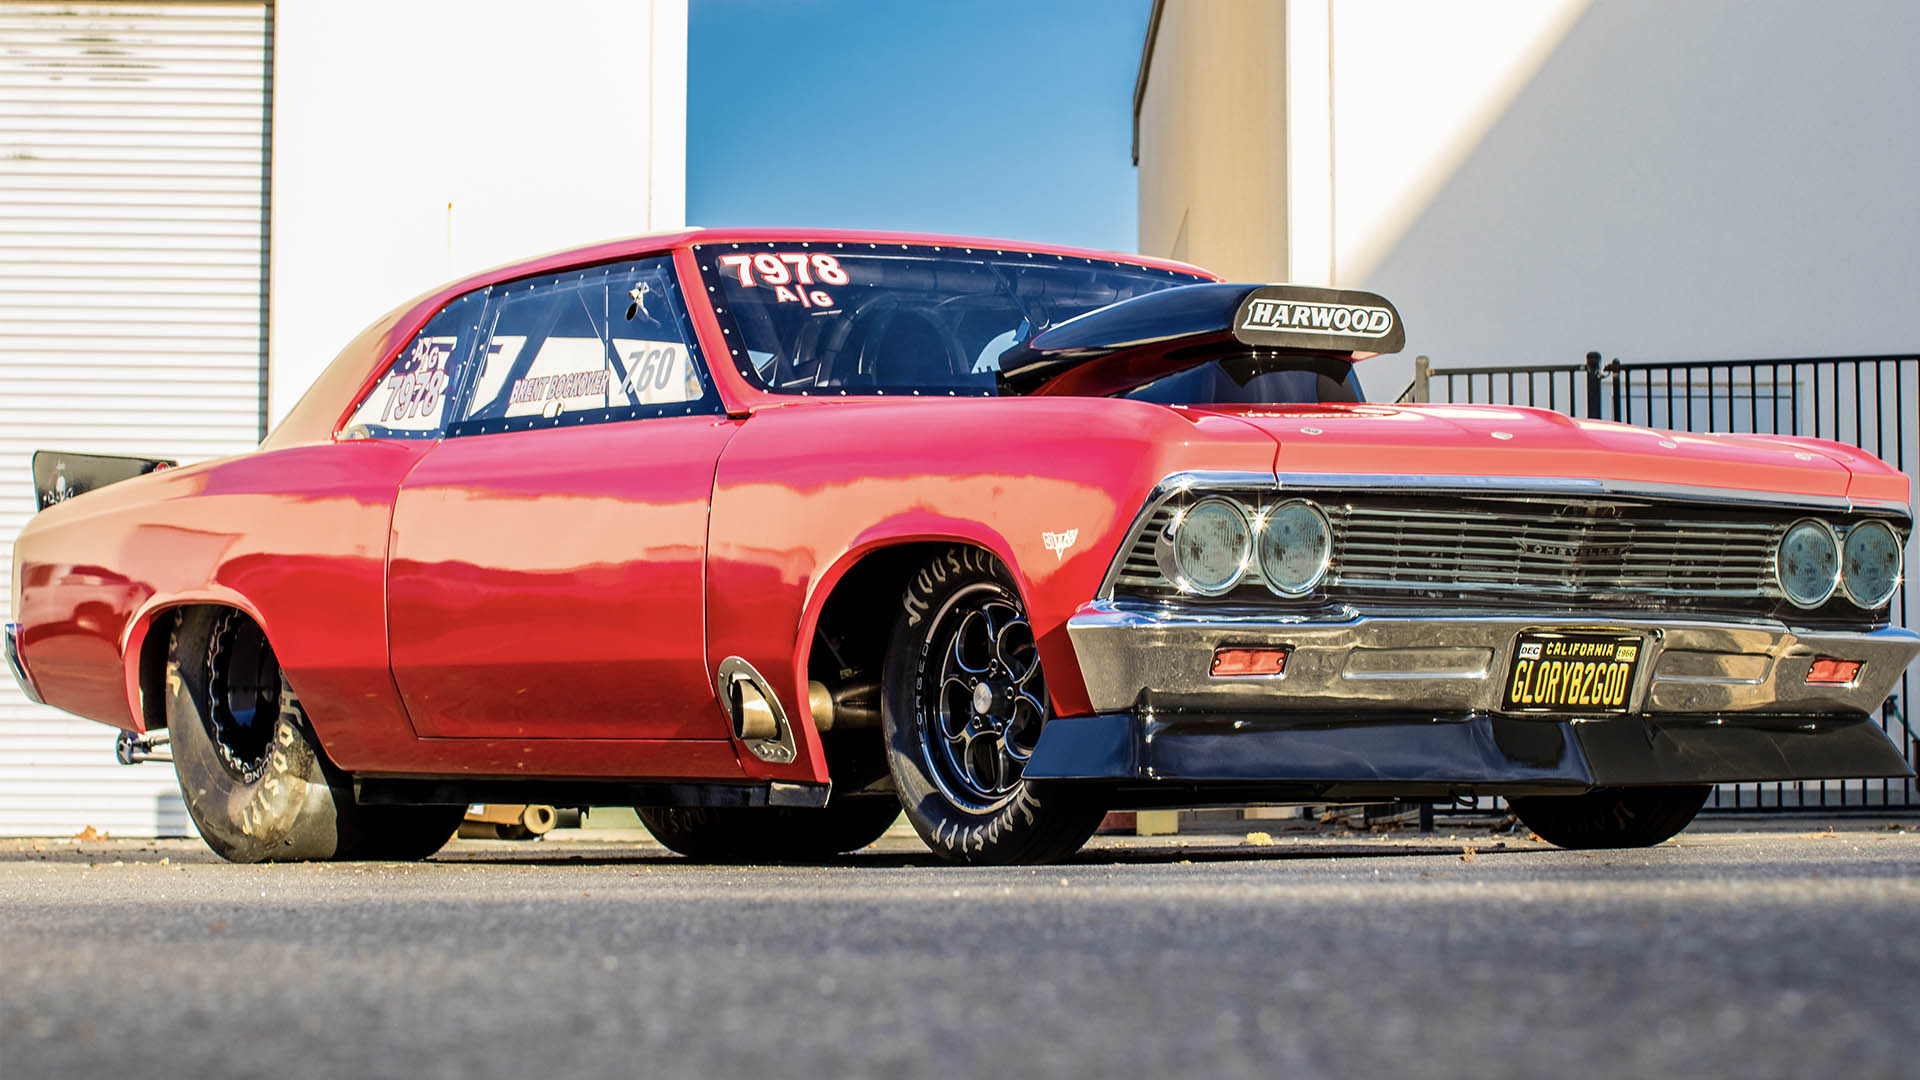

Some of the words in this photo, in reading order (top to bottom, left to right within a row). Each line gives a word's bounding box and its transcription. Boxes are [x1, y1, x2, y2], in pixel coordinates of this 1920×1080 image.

[719, 253, 849, 287] 7978
[1252, 303, 1391, 331] HARWOOD
[619, 347, 676, 395] 760
[381, 370, 446, 422] 7978
[509, 376, 551, 405] BRENT
[1521, 647, 1540, 656] DEC
[1546, 642, 1614, 657] CALIFORNIA
[1618, 649, 1635, 657] 1966
[1512, 660, 1630, 706] GLORYB2GOD
